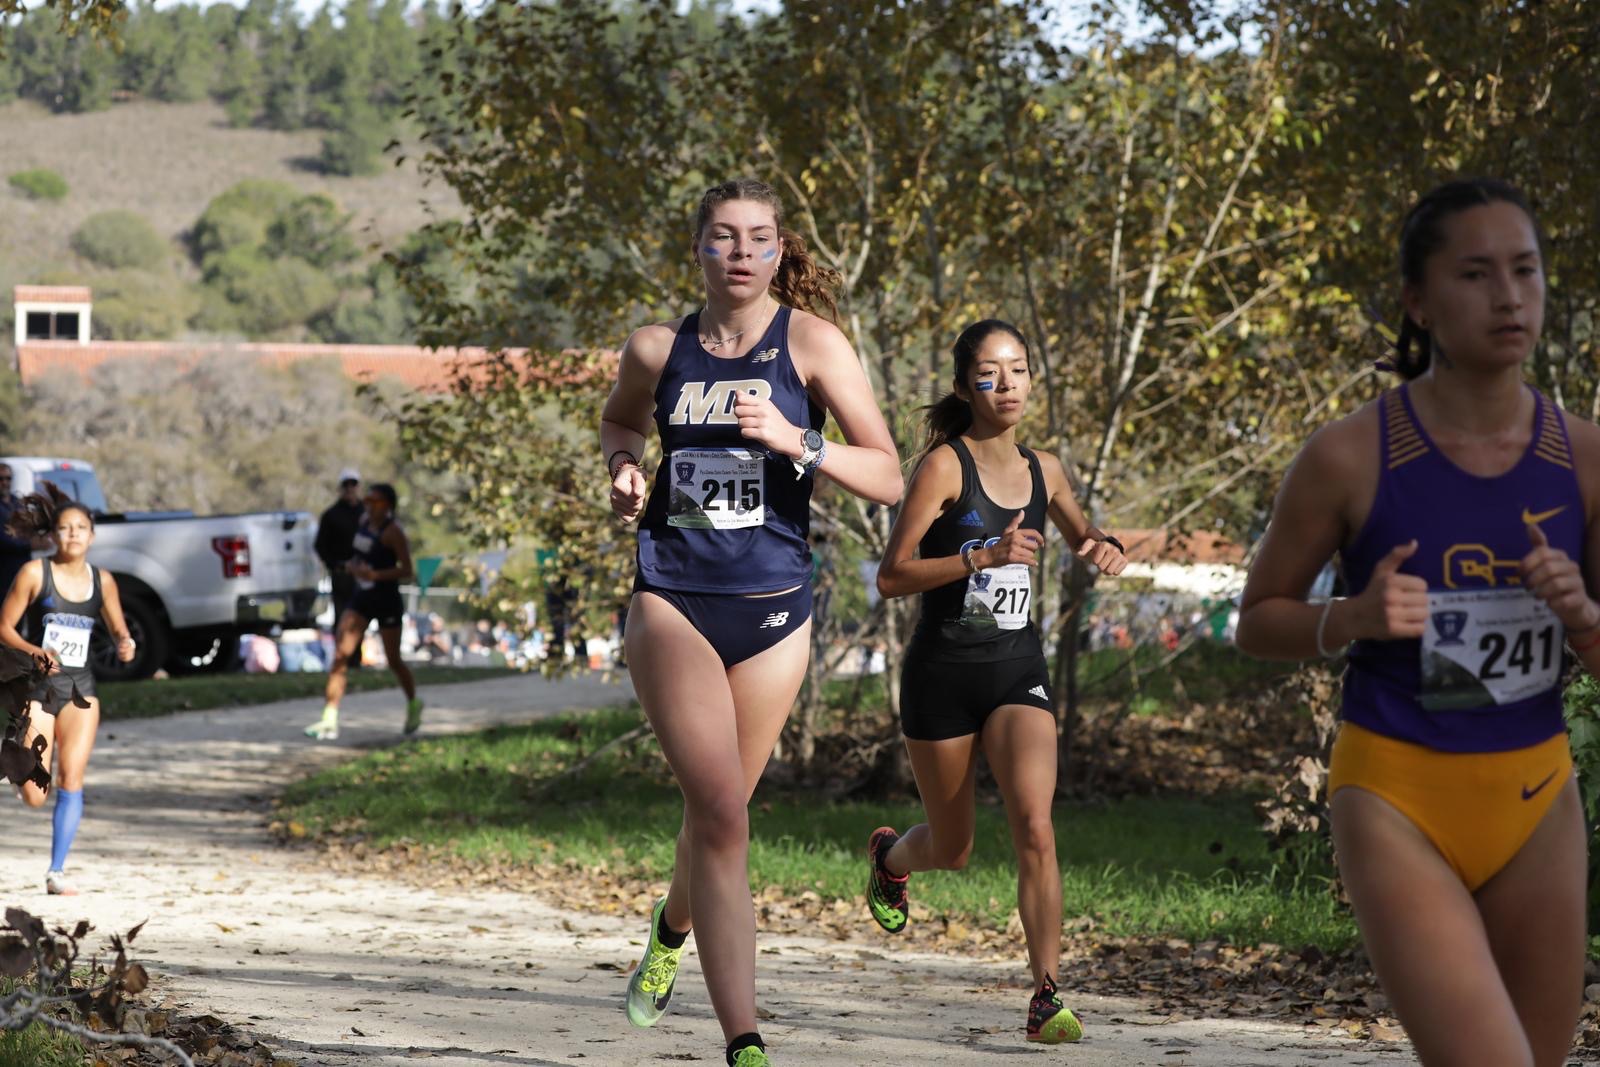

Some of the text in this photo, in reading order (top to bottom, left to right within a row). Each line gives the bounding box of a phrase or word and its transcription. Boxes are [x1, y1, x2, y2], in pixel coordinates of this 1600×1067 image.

[702, 479, 761, 512] 215
[992, 588, 1029, 614] 217
[60, 641, 84, 657] 221
[1479, 625, 1554, 680] 241
